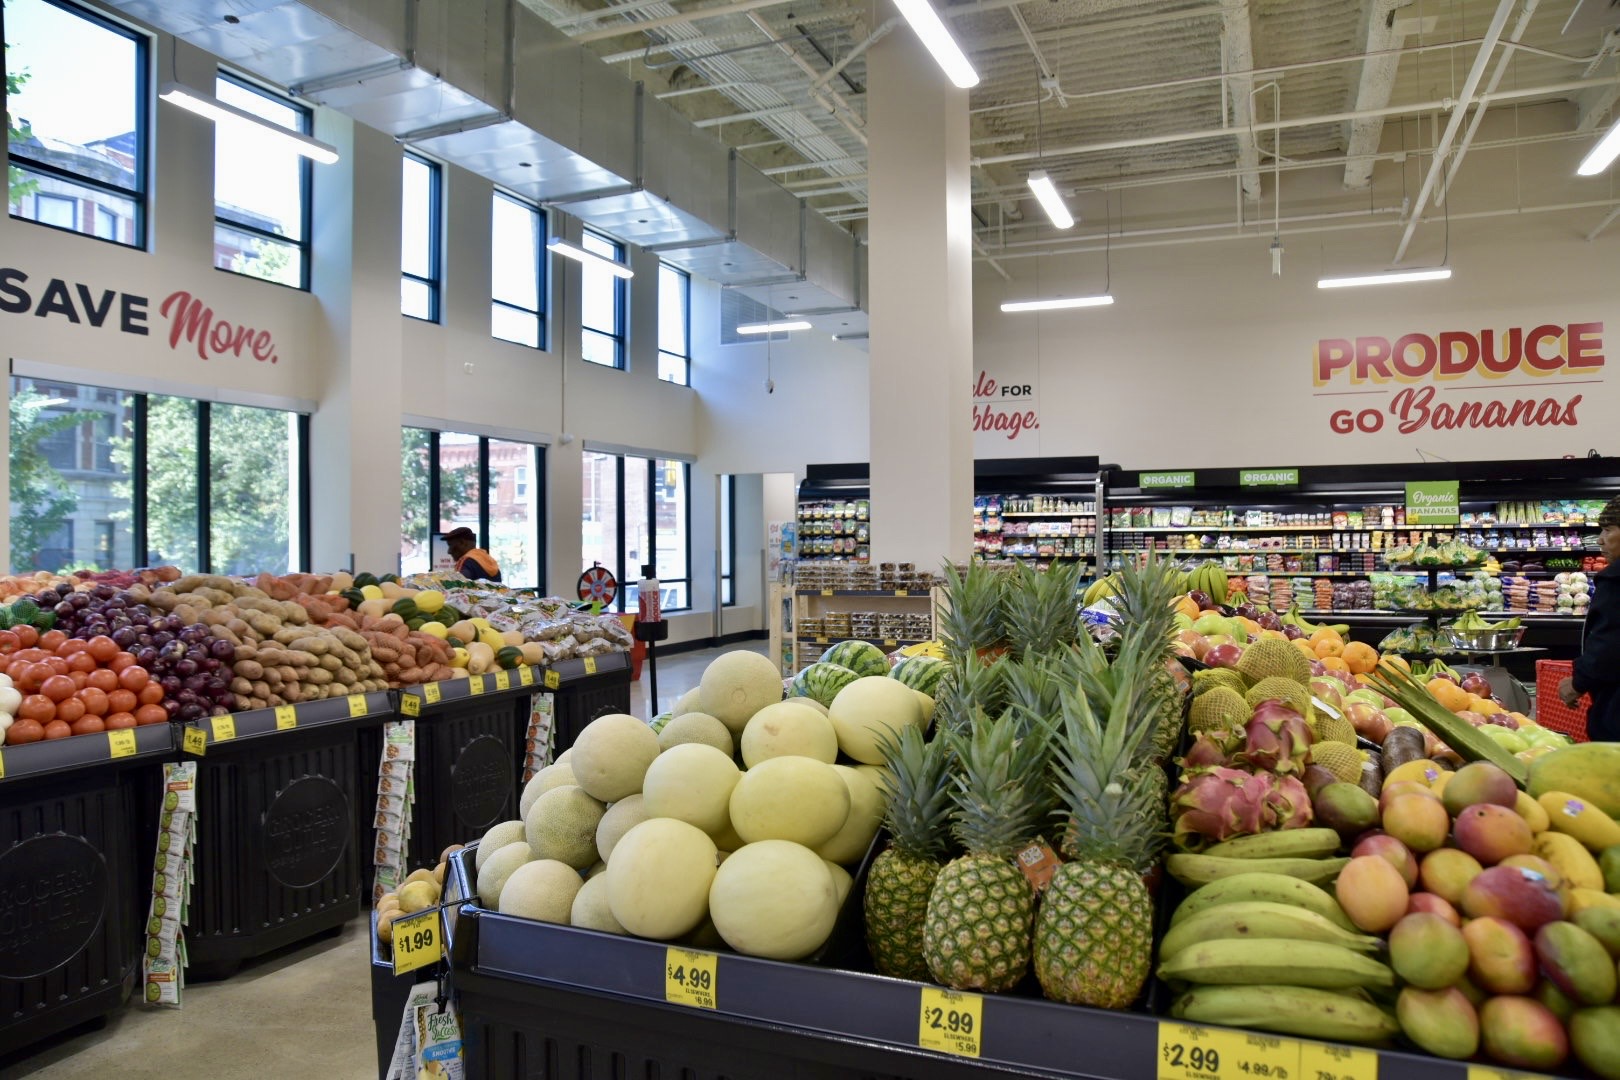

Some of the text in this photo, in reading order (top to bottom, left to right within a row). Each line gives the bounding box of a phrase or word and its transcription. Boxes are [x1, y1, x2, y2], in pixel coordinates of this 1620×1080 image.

[0, 267, 278, 364] SAVE More.
[1314, 322, 1605, 385] PRODUCE
[1002, 384, 1032, 397] FOR
[1330, 385, 1583, 435] GO Bananas
[1143, 474, 1191, 485] ORGANIC
[1244, 472, 1295, 482] ORGANIC
[1412, 490, 1455, 506] Organic
[1410, 507, 1457, 515] BANANAS
[399, 928, 433, 953] $1.99
[667, 963, 711, 990] $4.99
[427, 1011, 454, 1031] Fresh
[924, 1006, 973, 1035] $2.99
[431, 1025, 457, 1041] Success
[1163, 1042, 1219, 1073] $2.99
